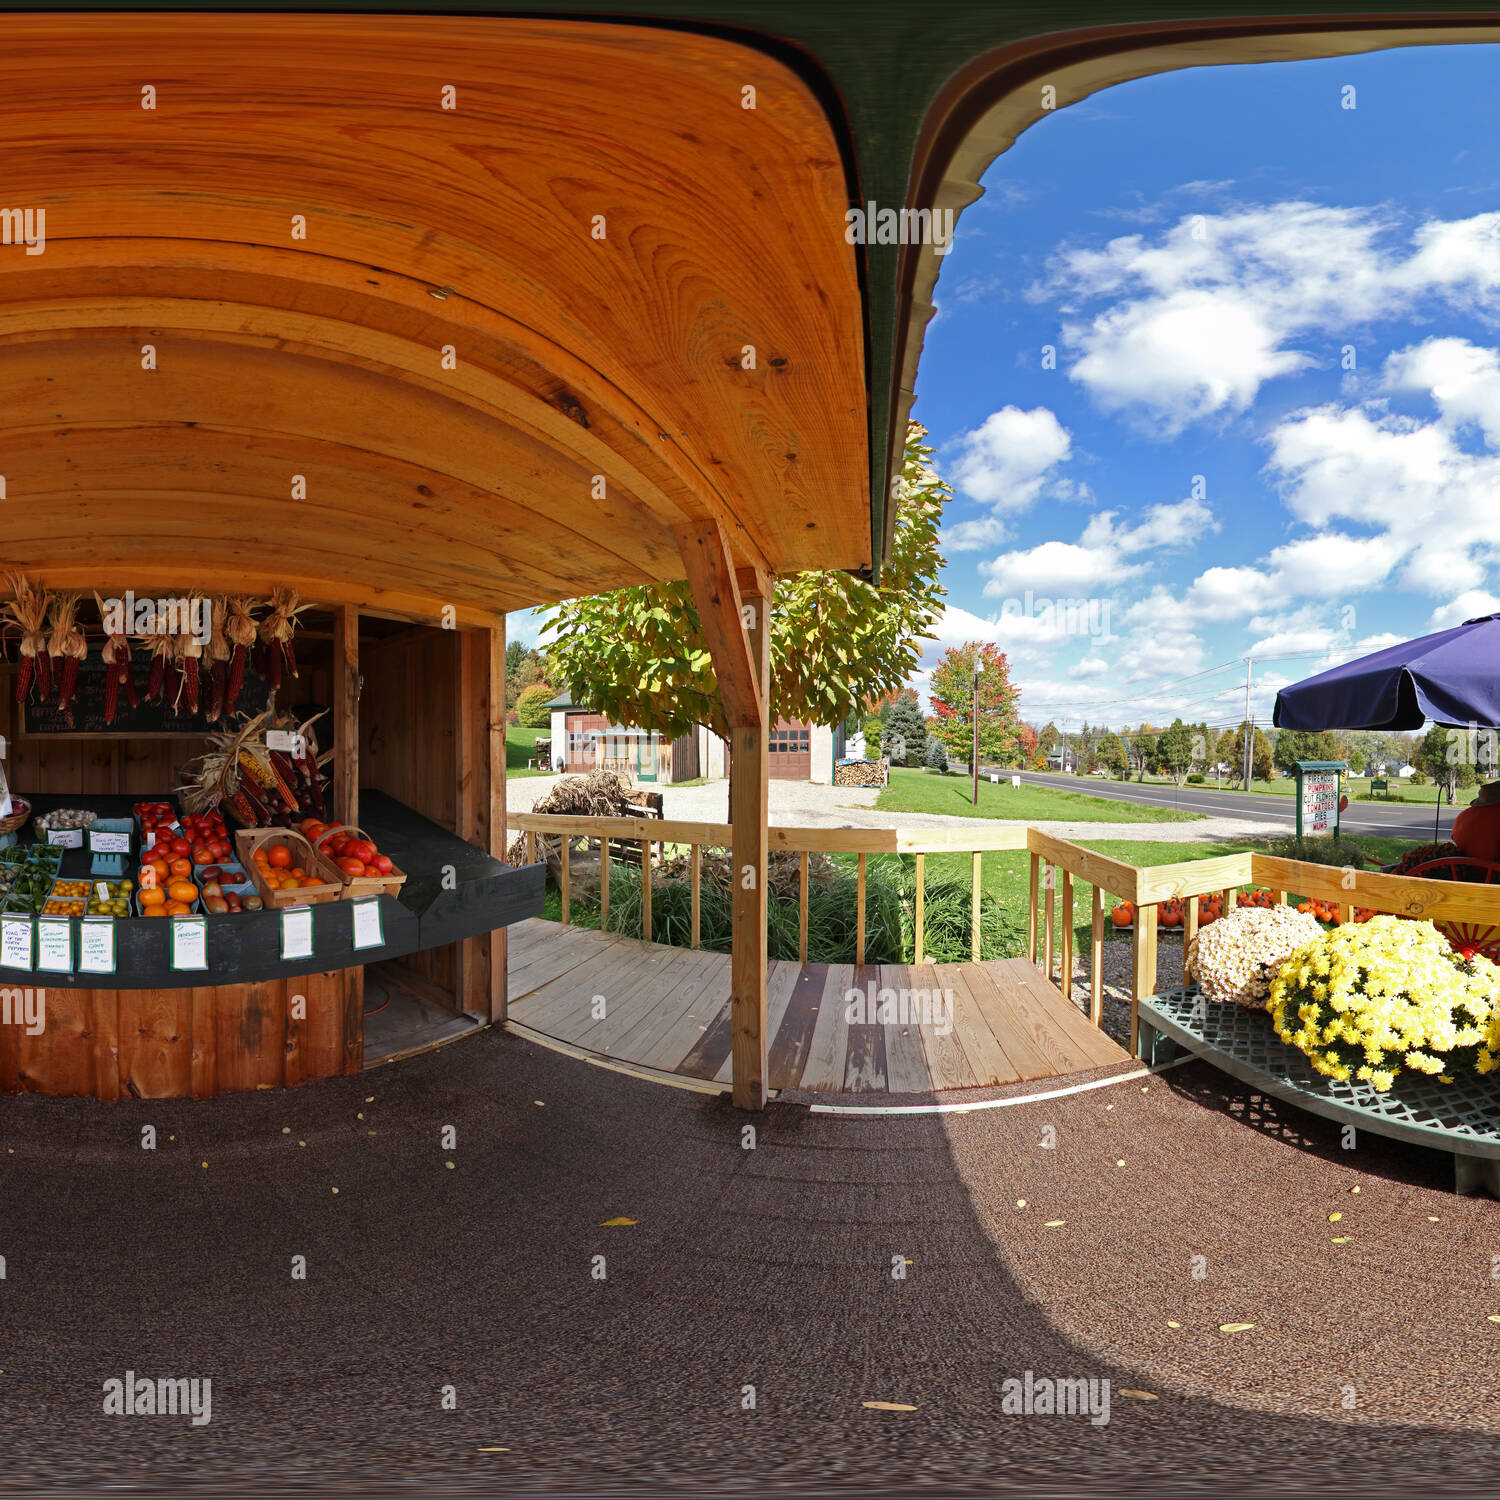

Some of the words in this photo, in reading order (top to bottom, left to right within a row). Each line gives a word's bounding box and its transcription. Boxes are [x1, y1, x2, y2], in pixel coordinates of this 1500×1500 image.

[1308, 784, 1334, 792] PUMPKINS
[1304, 795, 1314, 804] CUT
[1316, 792, 1337, 801] FLOWERS
[1307, 801, 1335, 812] TOMATOES
[1315, 811, 1327, 821] PIES
[1313, 821, 1328, 830] MUMS
